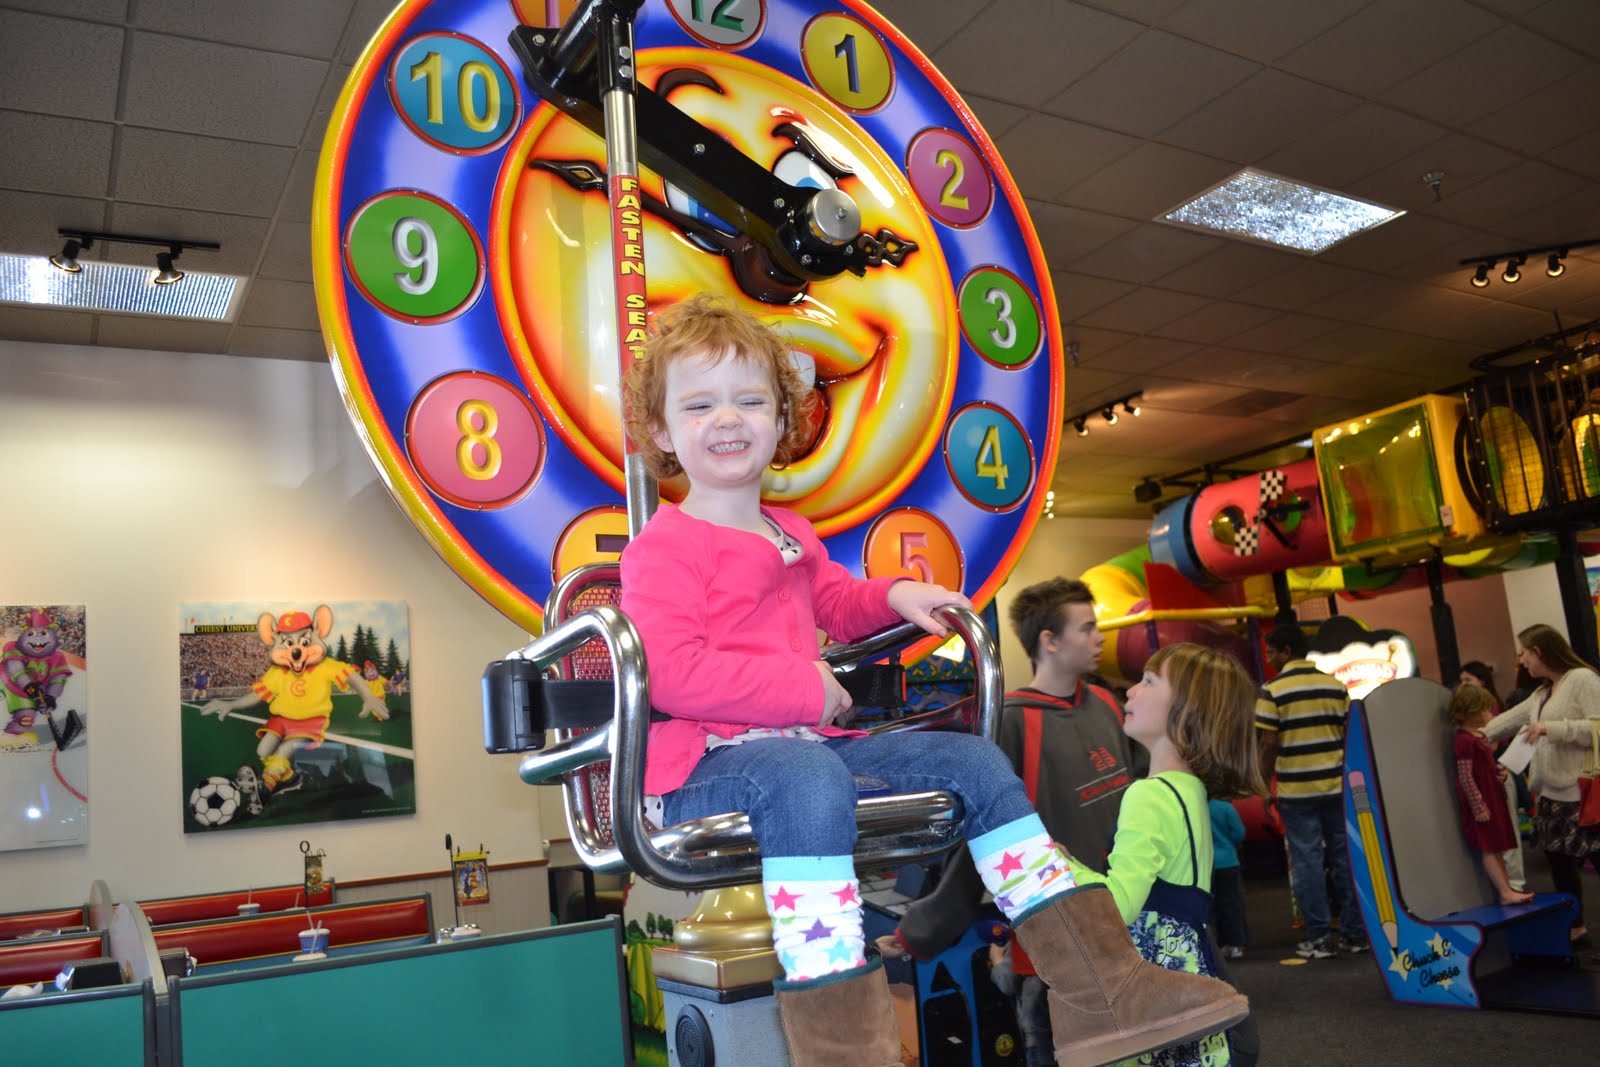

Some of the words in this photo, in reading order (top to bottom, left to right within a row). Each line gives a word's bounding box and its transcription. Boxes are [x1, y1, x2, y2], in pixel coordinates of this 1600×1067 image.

[410, 51, 501, 133] 10
[834, 33, 860, 94] 1
[935, 149, 970, 210] 2
[392, 216, 438, 295] 9
[616, 178, 645, 277] FASTEN
[624, 294, 648, 360] SEAT
[984, 287, 1017, 349] 3
[455, 399, 502, 481] 8
[975, 425, 1009, 490] 4
[900, 531, 934, 584] 5
[195, 624, 225, 633] CHEESY
[290, 679, 306, 697] C
[1402, 943, 1441, 972] Chuck
[1420, 965, 1460, 988] Cheese
